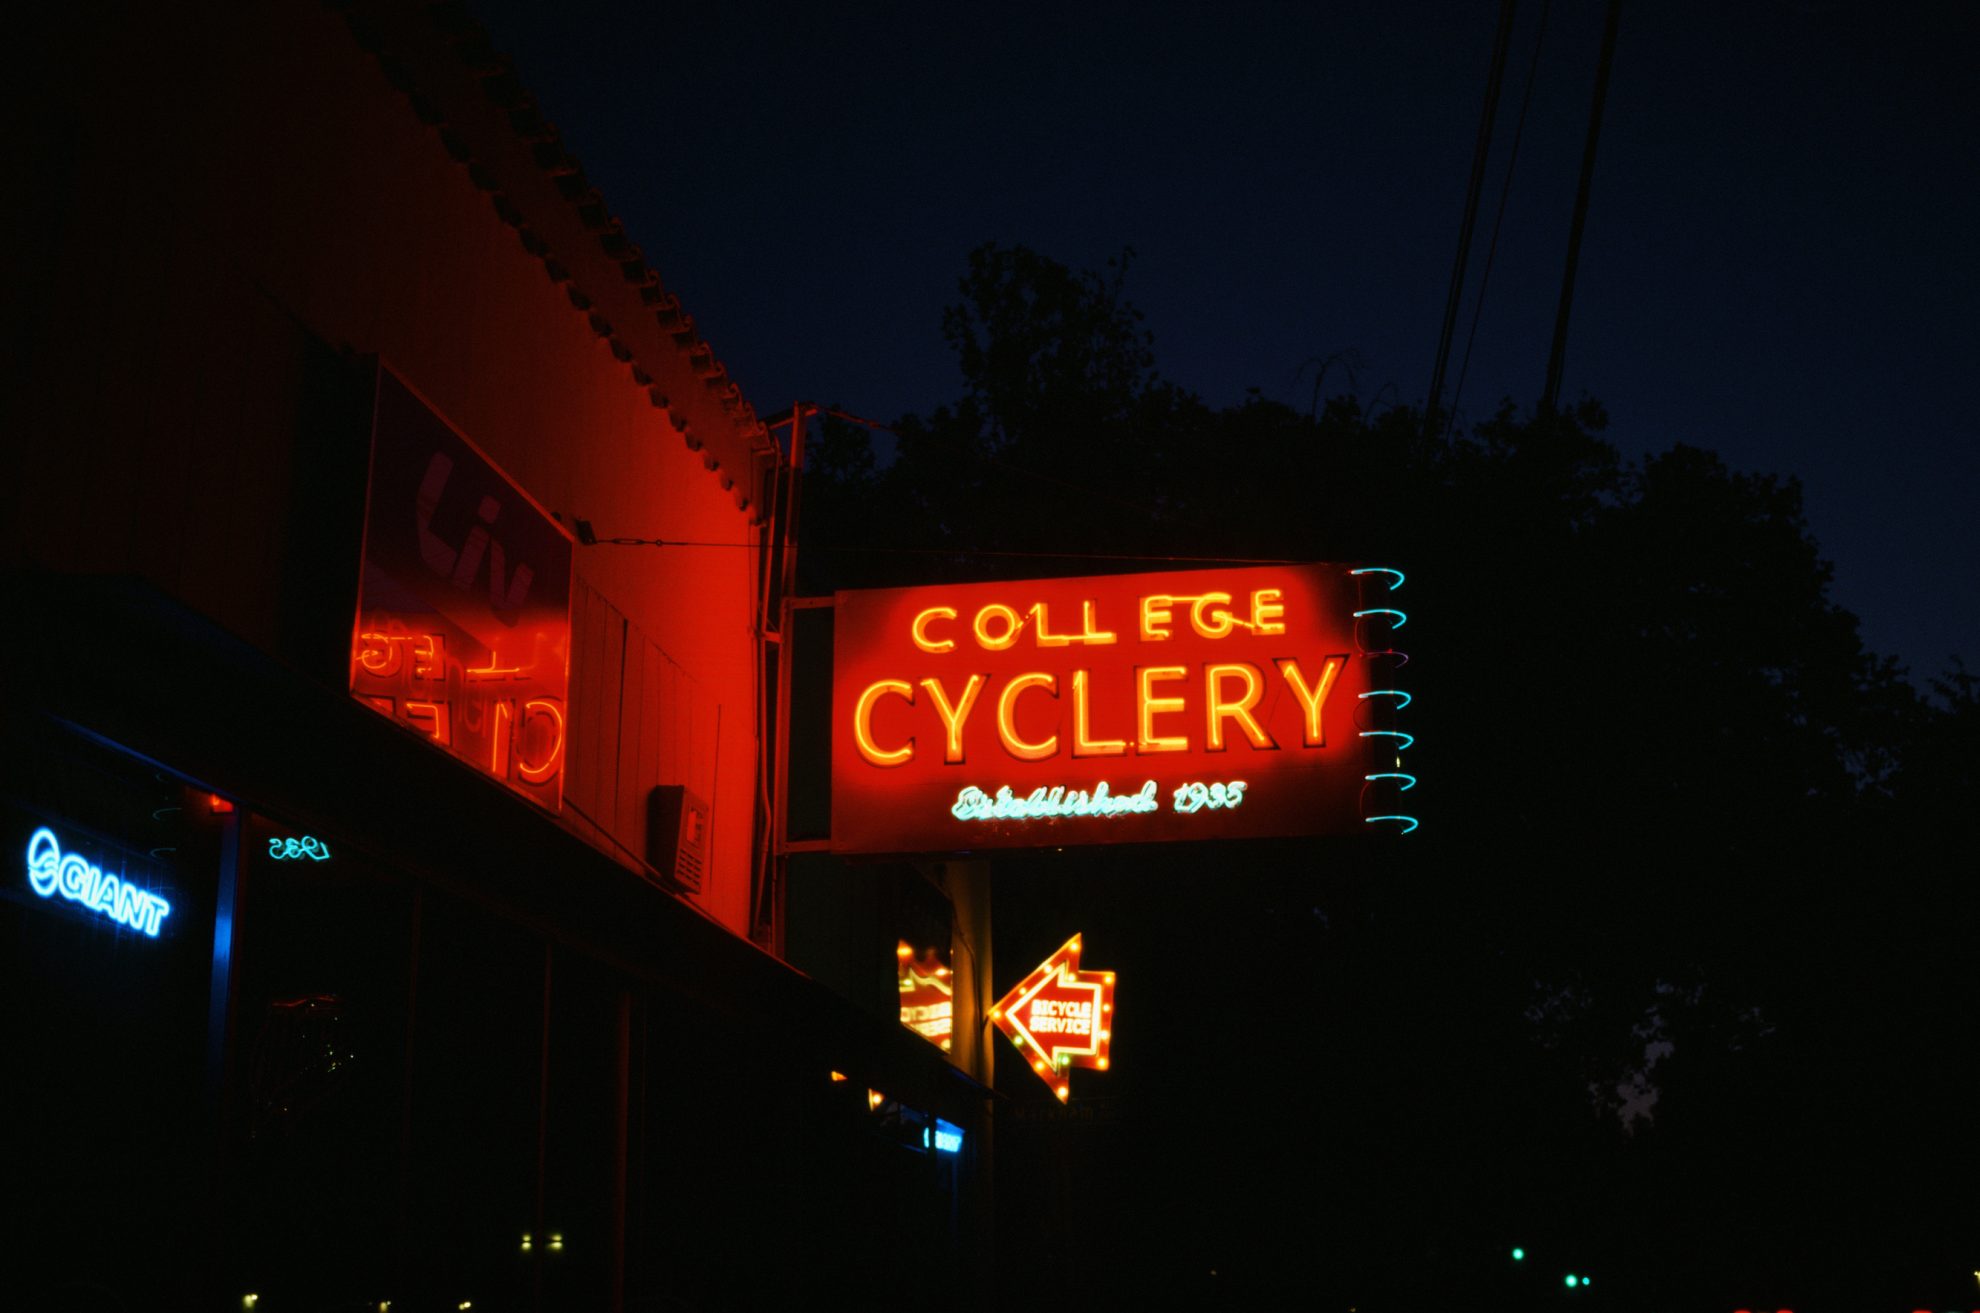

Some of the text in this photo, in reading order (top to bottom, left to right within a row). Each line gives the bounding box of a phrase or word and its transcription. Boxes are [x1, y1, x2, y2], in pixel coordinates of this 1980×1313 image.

[911, 589, 1285, 653] COLLEGE
[854, 655, 1349, 767] CYCLERY
[951, 781, 1246, 820] Established 1935
[58, 853, 170, 936] GIANT
[1030, 1016, 1090, 1034] SERVICE
[1031, 999, 1092, 1018] BICYCLE
